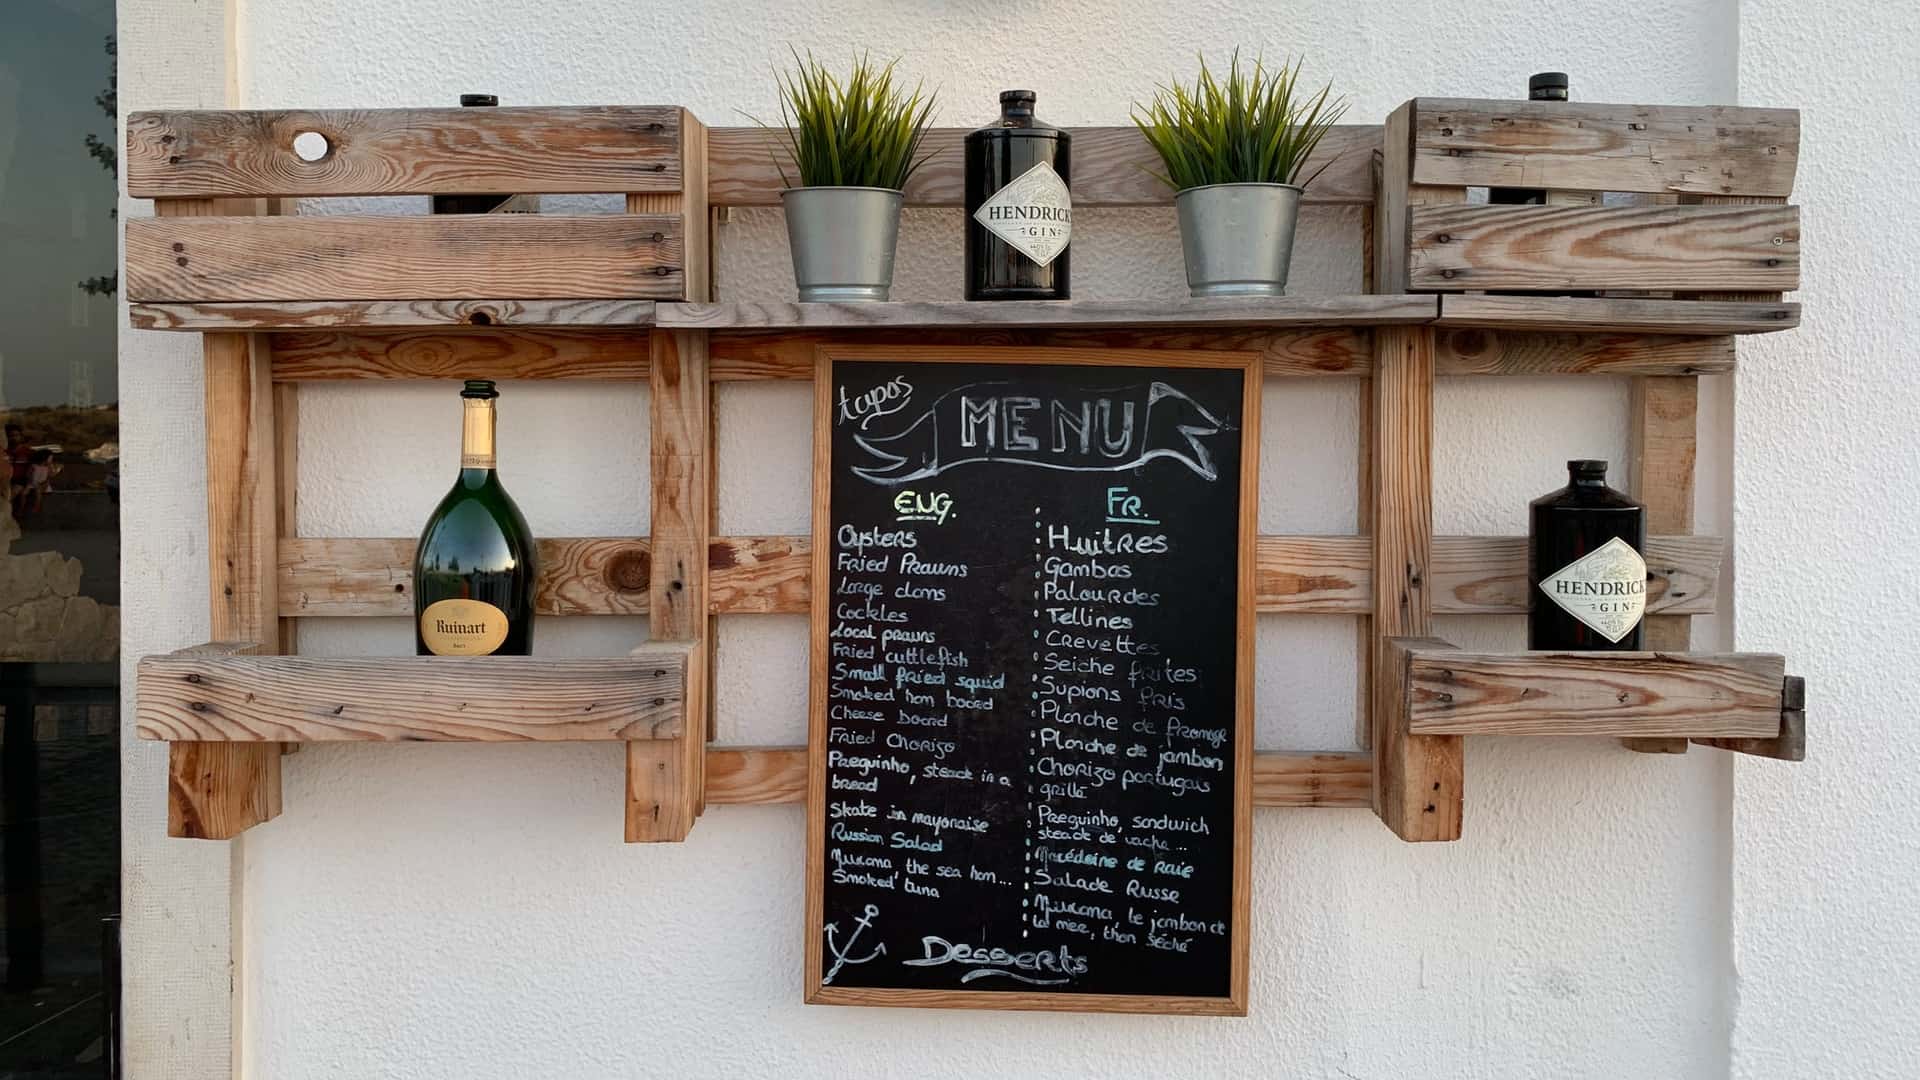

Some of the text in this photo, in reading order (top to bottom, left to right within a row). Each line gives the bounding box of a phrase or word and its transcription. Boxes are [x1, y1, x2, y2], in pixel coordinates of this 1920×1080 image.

[1029, 227, 1057, 236] GIN
[961, 395, 1134, 458] MENU
[1044, 557, 1132, 583] Gambas
[837, 602, 909, 622] Cockles
[1600, 602, 1629, 612] GIN
[436, 620, 486, 634] Ruinart
[1046, 607, 1133, 629] Tellines
[885, 647, 968, 671] cuttlefish
[1043, 653, 1115, 675] Seiche
[832, 663, 888, 681] Small
[955, 672, 1005, 694] squid
[830, 684, 895, 701] Smoked
[1040, 676, 1121, 704] Supions
[831, 705, 885, 721] Cheese
[1133, 719, 1156, 735] de
[981, 770, 994, 782] in
[830, 800, 877, 817] Skate
[887, 805, 906, 820] in
[890, 832, 943, 851] Salad
[1099, 832, 1116, 844] de
[906, 858, 929, 876] the
[936, 865, 962, 878] sea
[1127, 857, 1144, 871] de
[905, 878, 940, 898] tuna
[1127, 880, 1180, 903] Russe
[902, 936, 1088, 974] Desserts
